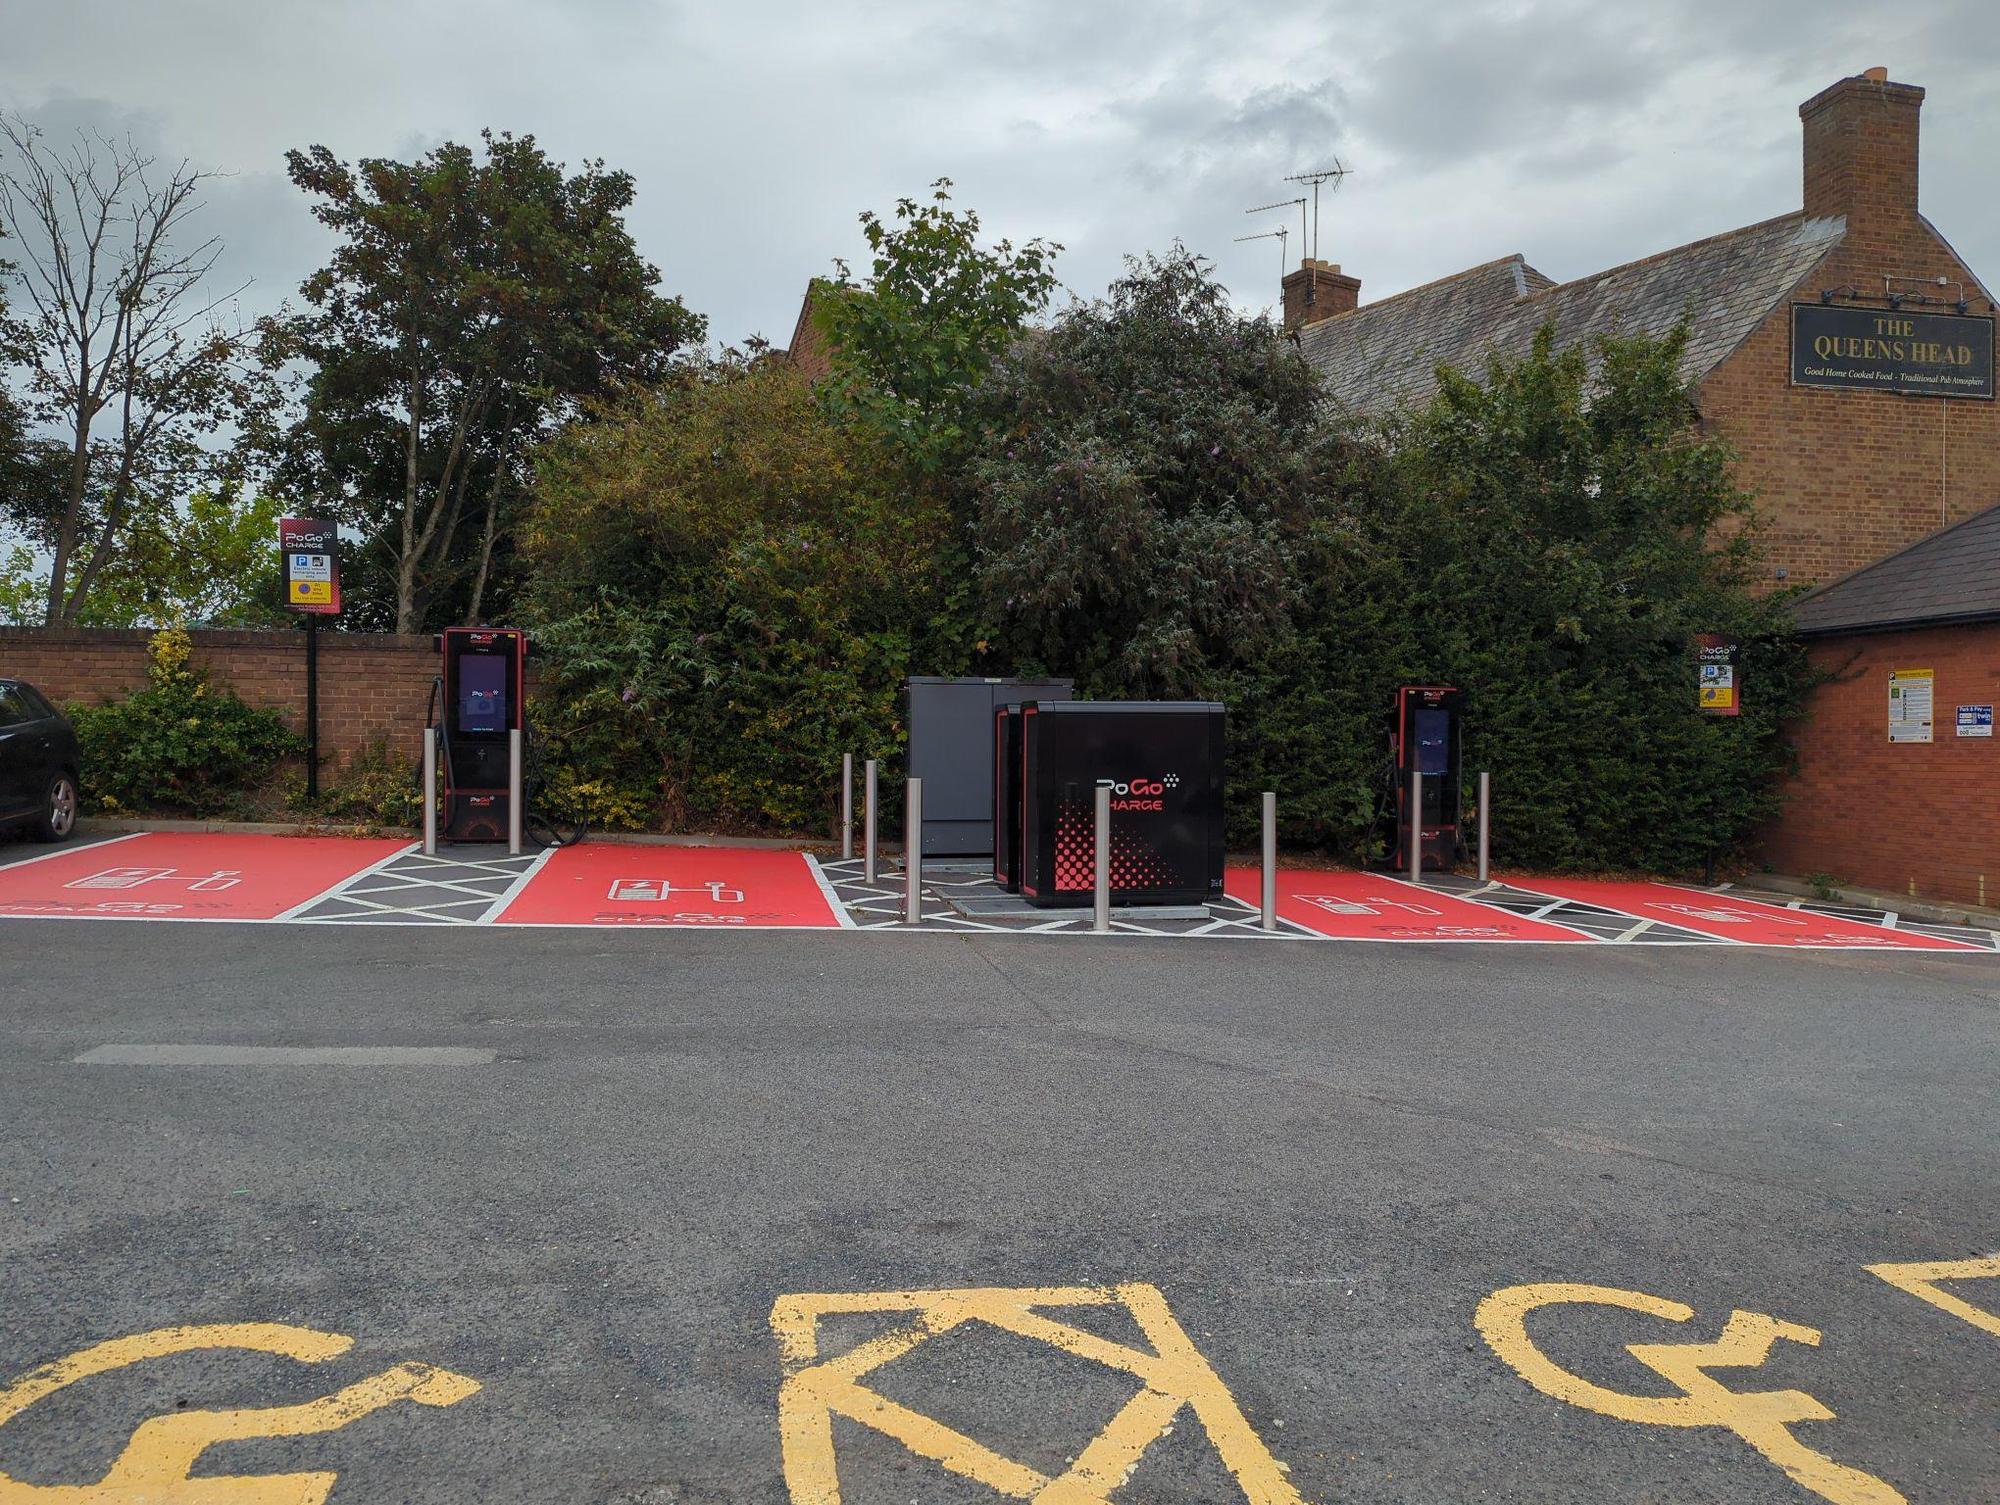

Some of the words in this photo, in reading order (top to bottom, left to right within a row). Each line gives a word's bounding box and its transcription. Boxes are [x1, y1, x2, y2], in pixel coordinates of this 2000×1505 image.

[1873, 318, 1915, 337] THE
[1814, 335, 1905, 361] QUEENS
[1911, 342, 1972, 366] HEAD
[1804, 366, 1825, 377] Good
[1826, 368, 1847, 378] Home
[1848, 369, 1874, 380] Cooked
[1875, 371, 1893, 381] Food
[1900, 372, 1939, 384] Traditional
[1940, 376, 1951, 385] Pub
[1952, 377, 1984, 387] Atmosphere
[1109, 799, 1163, 811] HARGE
